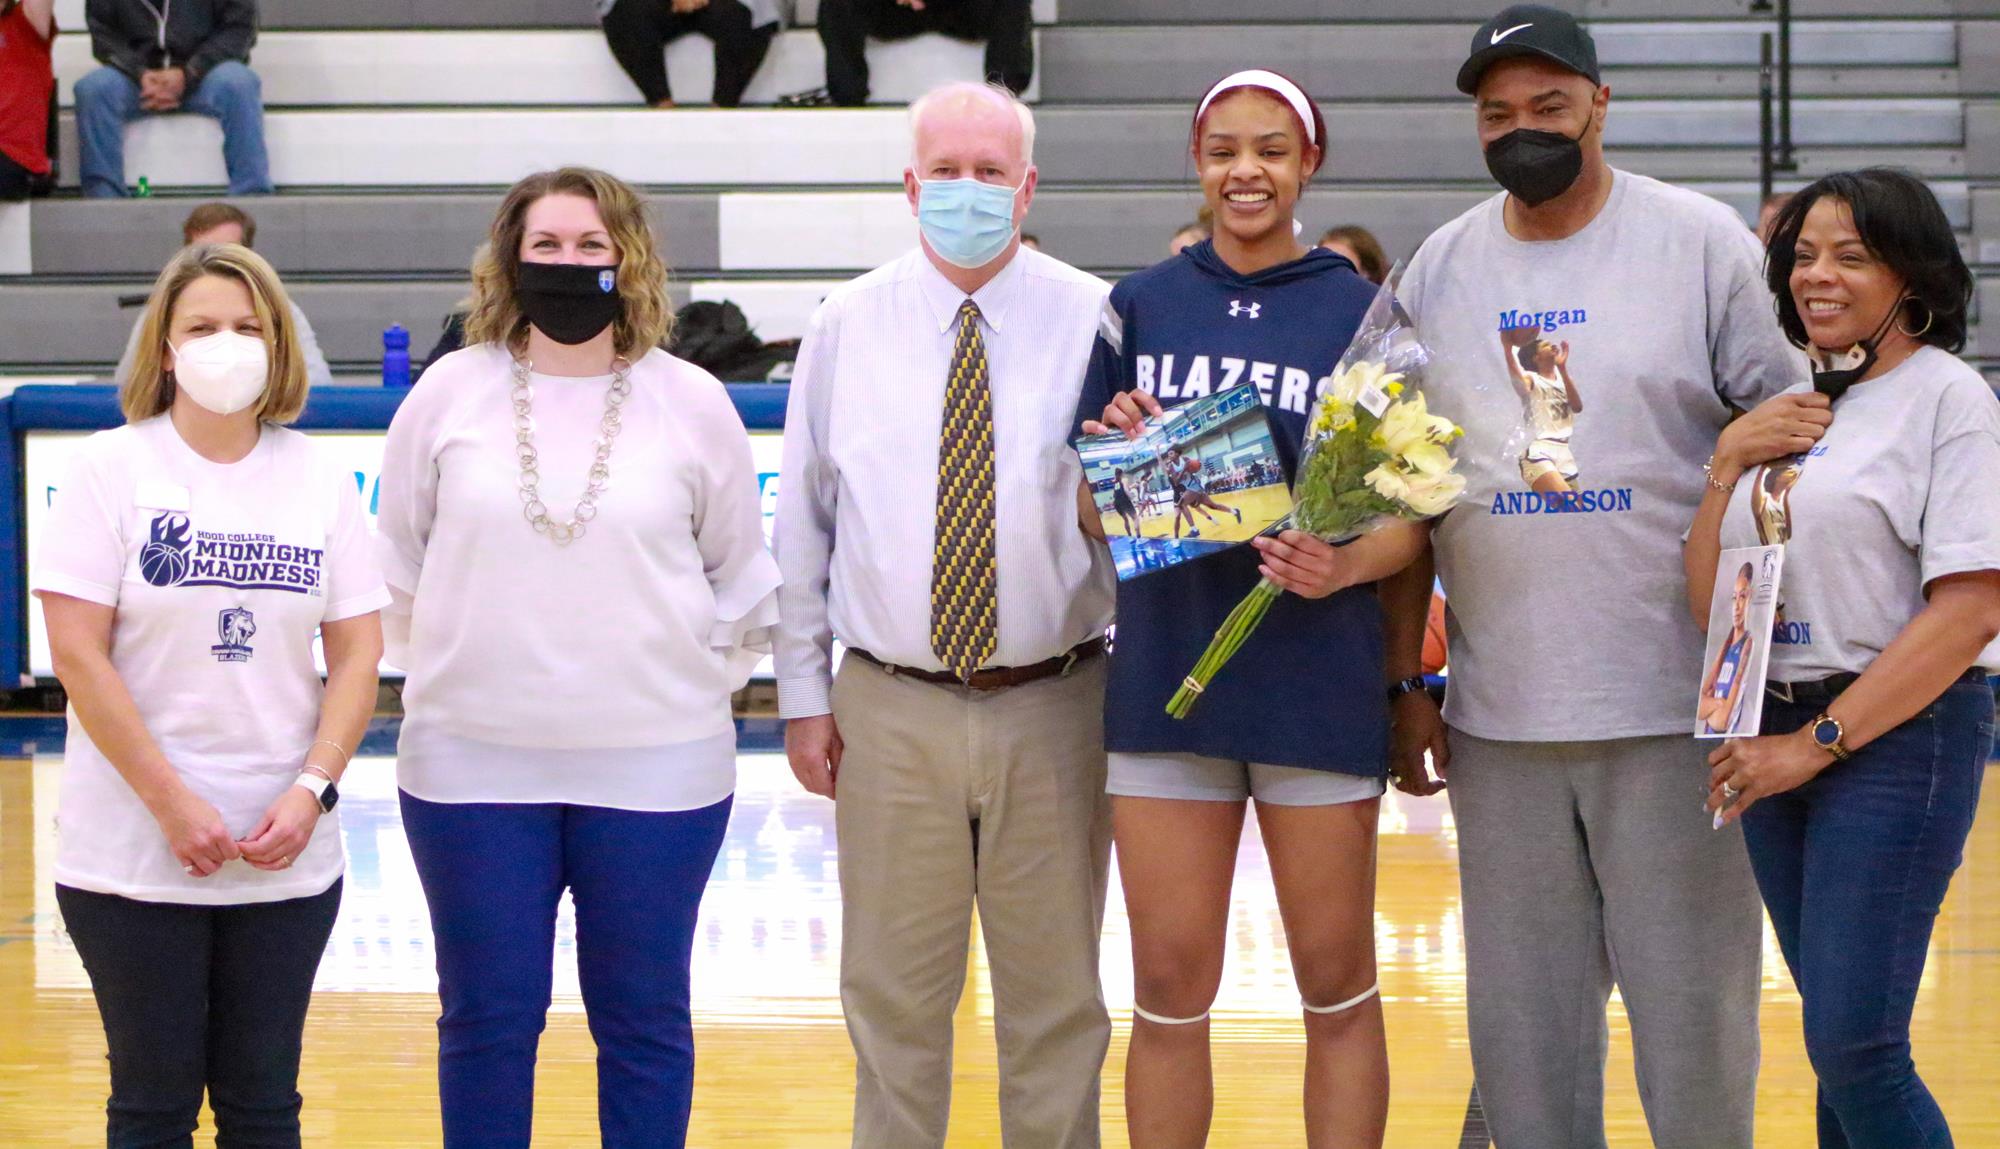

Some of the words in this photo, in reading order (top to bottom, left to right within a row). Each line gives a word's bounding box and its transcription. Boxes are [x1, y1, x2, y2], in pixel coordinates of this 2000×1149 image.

[1498, 308, 1587, 332] Morgan
[1490, 488, 1633, 515] ANDERSON
[197, 530, 225, 541] HOOD
[227, 533, 276, 543] COLLEGE
[195, 539, 324, 567] MIDNIGHT
[190, 559, 320, 588] MADNESS!
